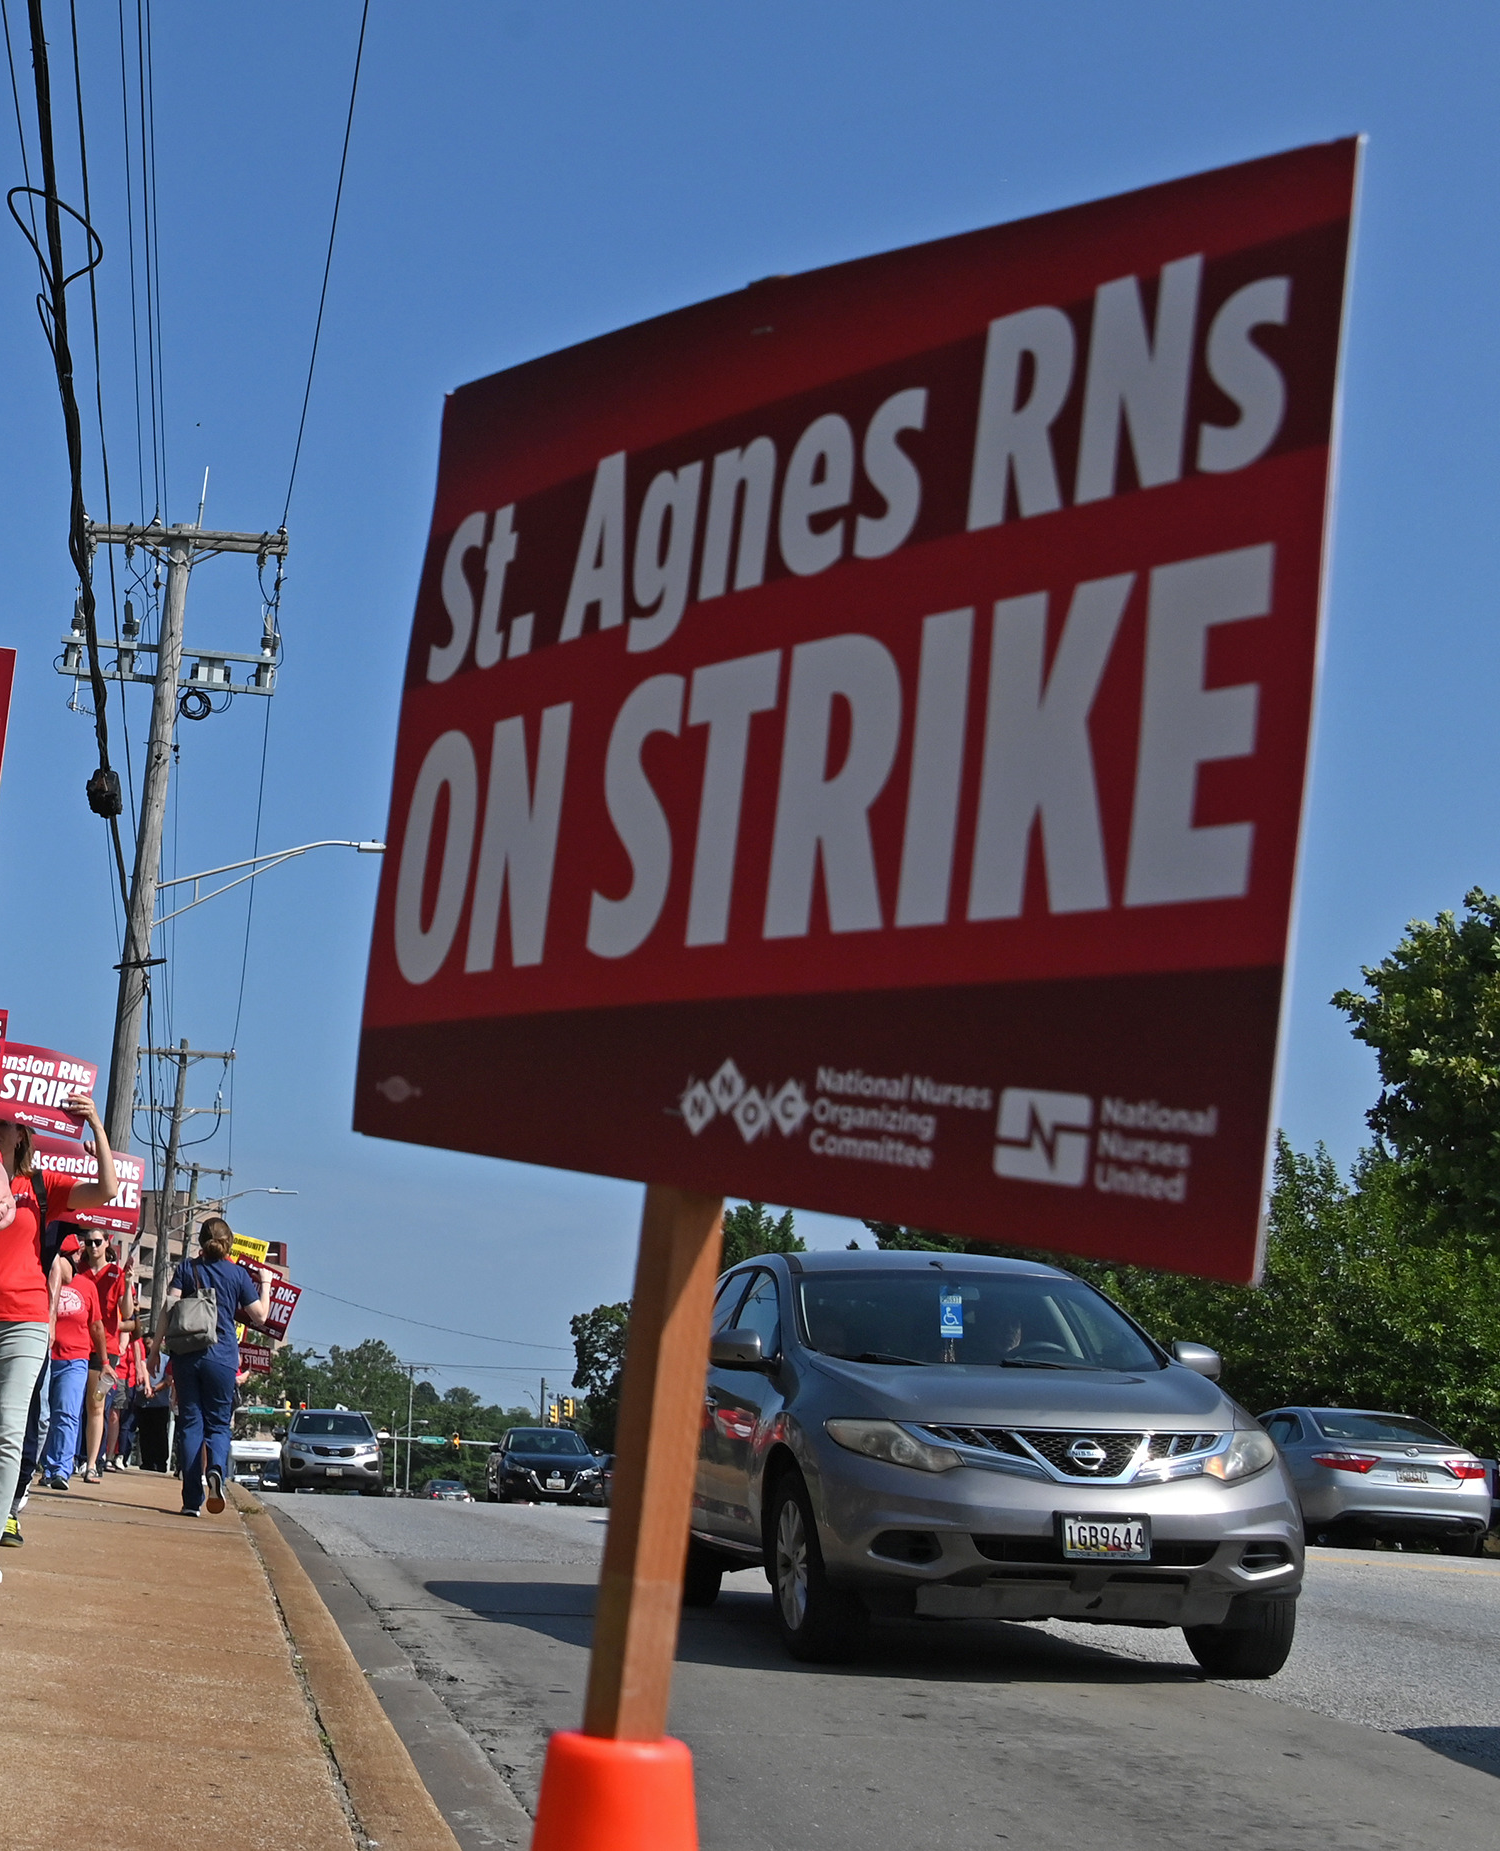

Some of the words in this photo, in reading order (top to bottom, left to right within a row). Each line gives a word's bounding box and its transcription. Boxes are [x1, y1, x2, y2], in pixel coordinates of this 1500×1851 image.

[426, 502, 534, 684] St.
[559, 387, 928, 655] Agnes
[967, 252, 1289, 533] RNs
[393, 701, 573, 985] ON
[585, 541, 1276, 960] STRIKE
[2, 1055, 55, 1077] nsion
[57, 1060, 92, 1084] RNs
[815, 1066, 909, 1101] National
[910, 1075, 993, 1111] Nurses
[812, 1099, 936, 1141] Organizing
[1100, 1097, 1217, 1137] National
[31, 1150, 99, 1175] Ascensio
[113, 1159, 140, 1180] RNs
[809, 1127, 934, 1170] Committee
[1097, 1131, 1190, 1168] Nurses
[1094, 1161, 1187, 1202] United
[233, 1237, 266, 1252] OMMUNITY
[275, 1286, 297, 1304] RNs
[244, 1355, 270, 1367] STRIKE
[1068, 1526, 1145, 1548] 1GB9644
